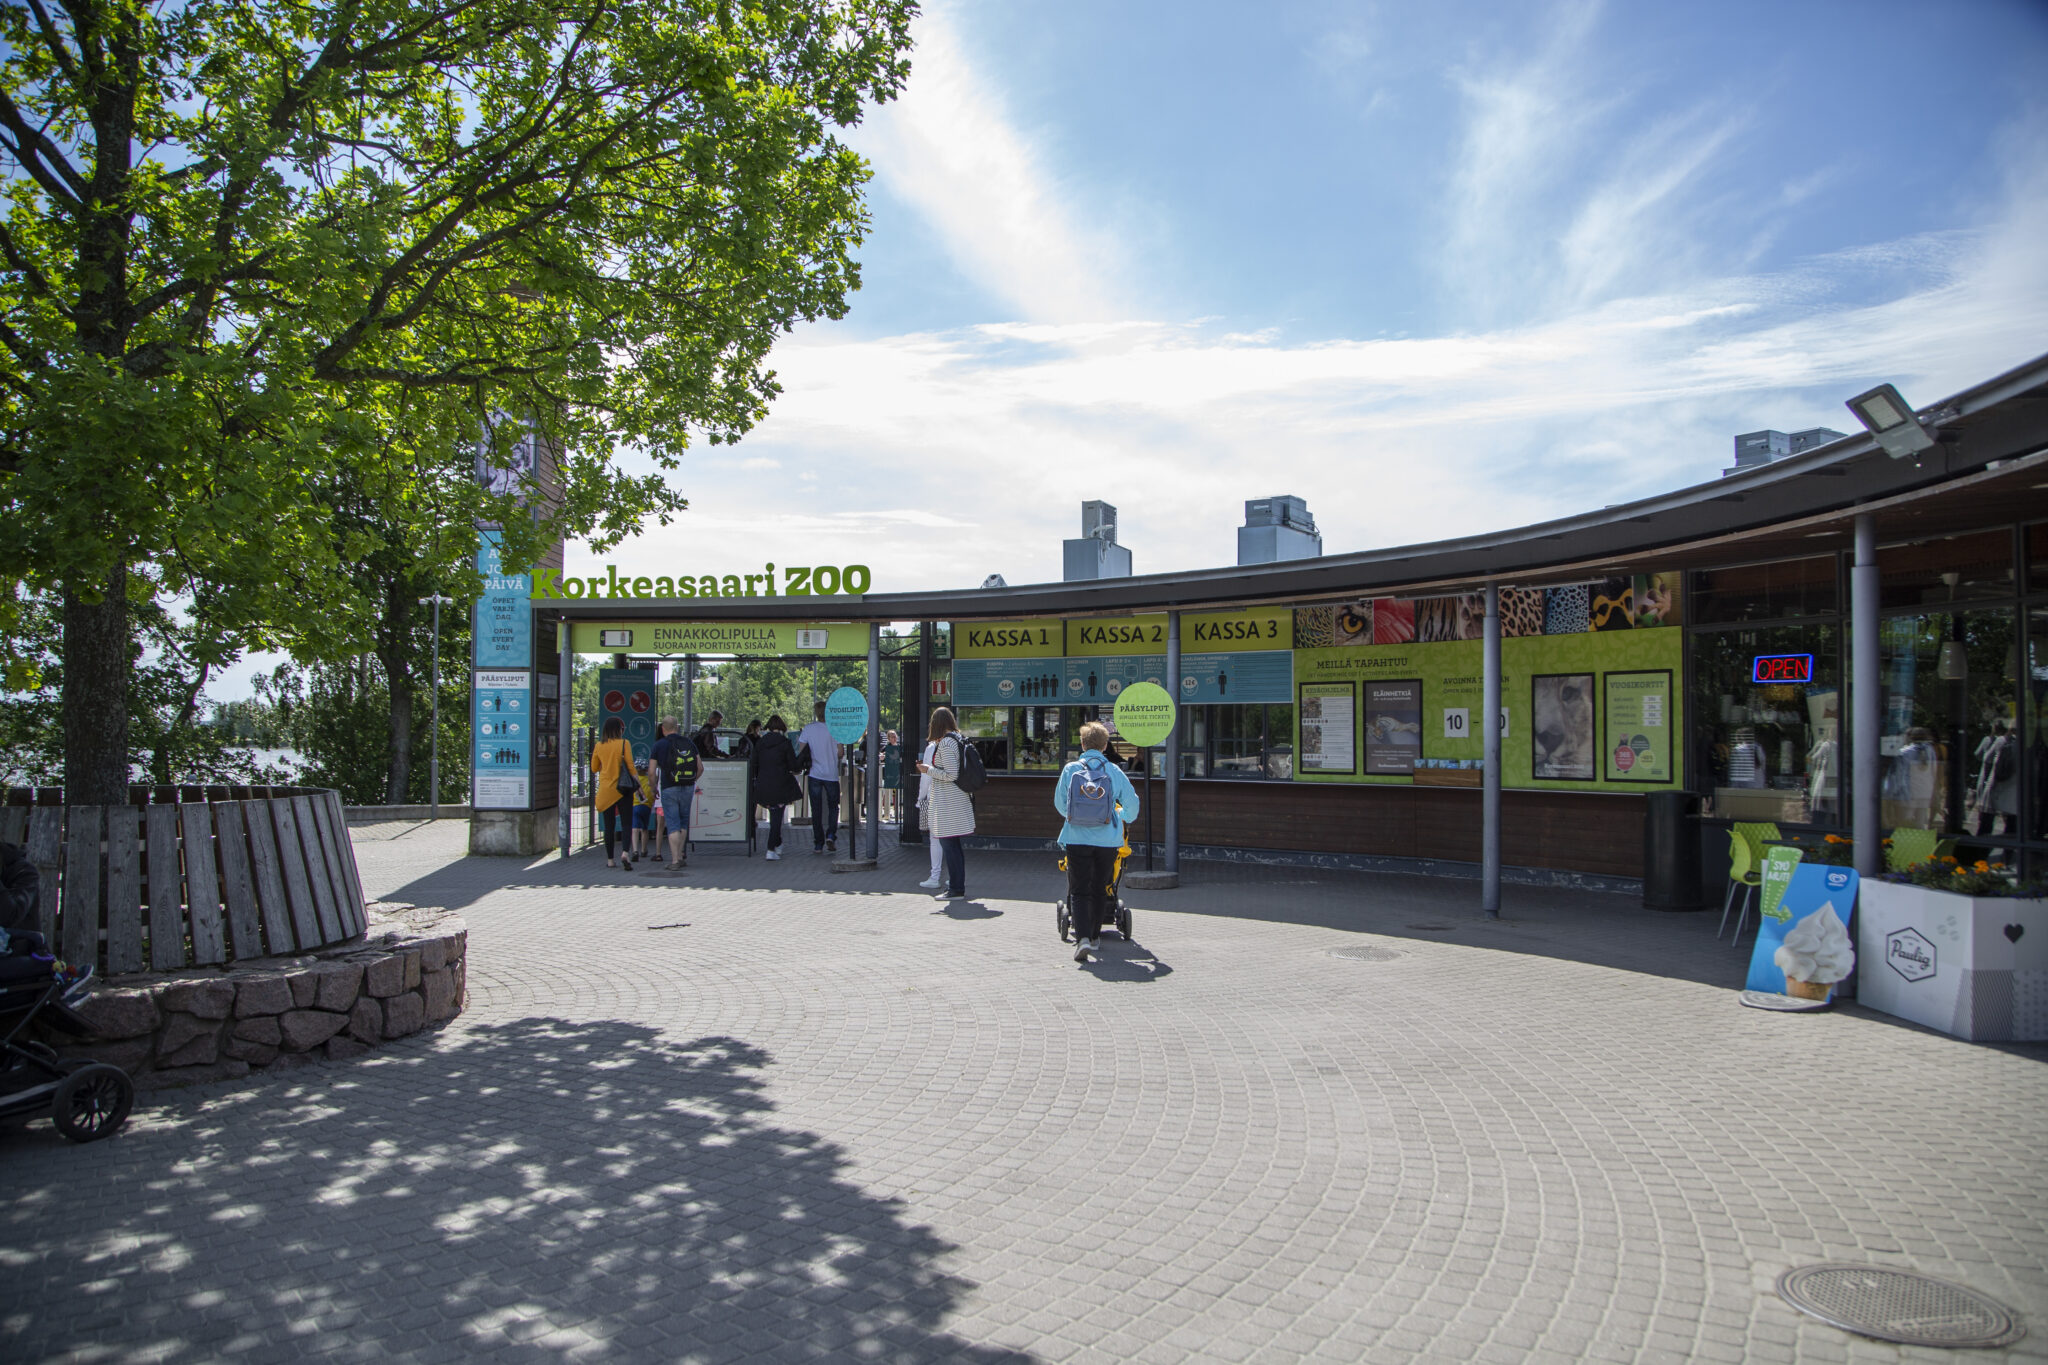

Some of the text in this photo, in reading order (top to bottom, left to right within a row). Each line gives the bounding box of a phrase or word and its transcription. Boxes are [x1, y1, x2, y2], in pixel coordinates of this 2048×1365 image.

[484, 577, 524, 590] PÄIVÄ
[530, 562, 871, 599] Korkeasaari ZOO
[654, 628, 776, 640] ENNAKKOLIPULLA
[1080, 625, 1162, 644] KASSA 2
[1194, 620, 1278, 641] KASSA 3
[969, 628, 1049, 647] KASSA 1
[653, 640, 776, 649] SUORAAN PORTISTA SISÄÄN
[1317, 657, 1408, 669] MEILLÄ TAPAHTUU
[1756, 657, 1809, 680] OPEN
[1443, 676, 1477, 684] AVOINNA
[1610, 681, 1664, 689] VUOSIKORTIT
[1373, 689, 1412, 697] ELÄINHETKIÄ
[1120, 704, 1170, 712] PÄÄSYLIPUT
[1446, 714, 1462, 730] 10
[1891, 939, 1930, 971] Paulig
